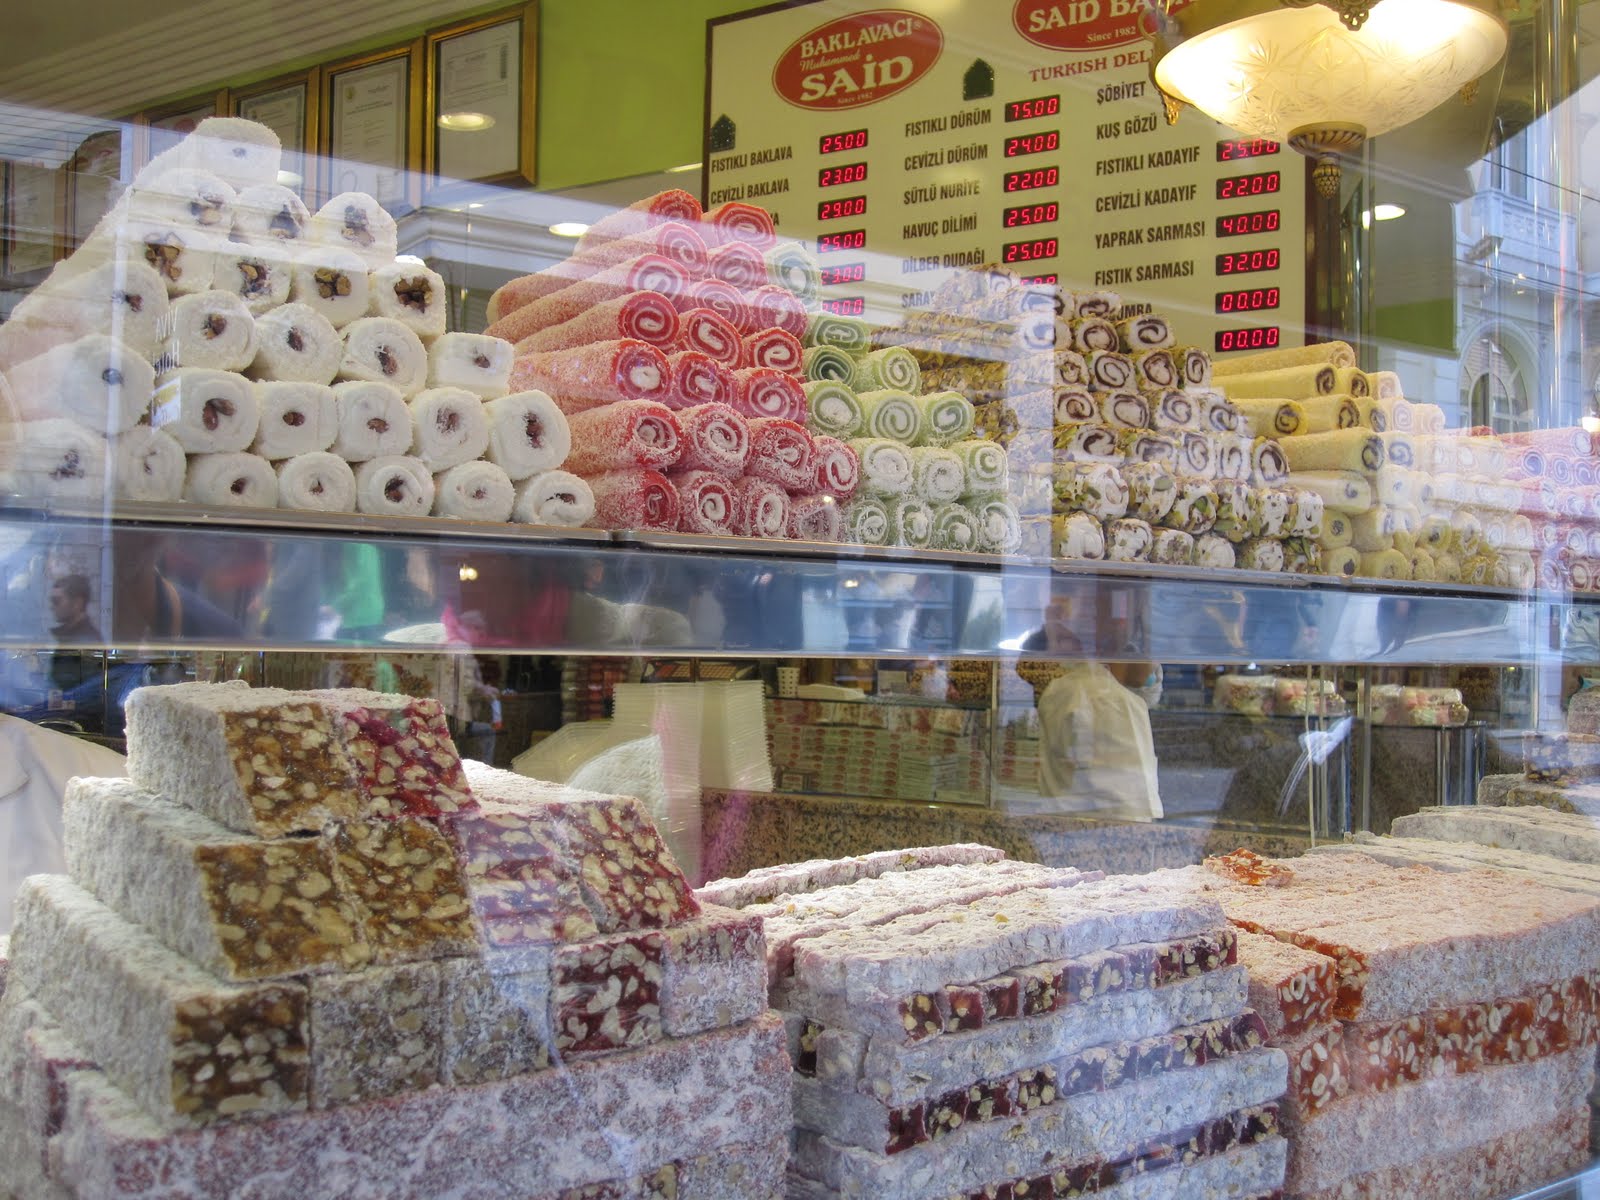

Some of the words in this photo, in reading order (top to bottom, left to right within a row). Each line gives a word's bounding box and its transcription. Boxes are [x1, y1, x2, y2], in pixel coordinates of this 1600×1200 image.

[801, 17, 914, 58] BAKLAVACI
[1087, 31, 1113, 42] Since
[1115, 26, 1137, 38] 1982
[800, 54, 914, 101] SAİD
[1029, 57, 1108, 82] TURKISH
[1113, 49, 1151, 68] DEL
[1096, 81, 1147, 105] ŞÖBİYET
[1011, 98, 1058, 118] 75.00
[905, 118, 948, 137] FISTIKLI
[951, 108, 992, 129] DÜRÜM
[1096, 122, 1121, 140] KUŞ
[1124, 112, 1158, 135] GÖZÜ
[822, 132, 866, 153] 25.00
[1007, 133, 1057, 156] 24.00
[711, 153, 748, 173] FISTIKLI
[750, 145, 793, 166] BAKLAVA
[904, 147, 944, 171] CEVİZLİ
[947, 143, 988, 164] DÜRÜM
[1096, 155, 1144, 176] FISTIKLI
[1148, 146, 1201, 169] KADAYIF
[821, 165, 866, 186] 23.00
[1007, 169, 1057, 191] 22.00
[1222, 174, 1278, 197] 22.00
[710, 186, 745, 205] CEVİZLİ
[747, 178, 789, 199] BAKLAVA
[903, 184, 937, 205] SÜTLÜ
[940, 179, 981, 200] NURİYE
[1096, 189, 1141, 213] CEVİZLİ
[1144, 184, 1197, 206] KADAYIF
[821, 198, 866, 220] 29.00
[1007, 204, 1057, 227] 25.00
[903, 219, 939, 240] HAVUÇ
[942, 212, 977, 234] DİLİMİ
[1095, 228, 1143, 249] YAPRAK
[1146, 221, 1205, 243] SARMASI
[1223, 212, 1278, 233] 40.00
[902, 256, 940, 274] DİLBER
[943, 248, 985, 269] DUDAĞI
[1007, 240, 1057, 262] 25.00
[1222, 250, 1278, 273] 32.00
[1095, 268, 1133, 286] FISTIK
[1136, 260, 1194, 282] SARMASI
[1222, 289, 1278, 311] 00.00
[1222, 328, 1278, 349] 00.00
